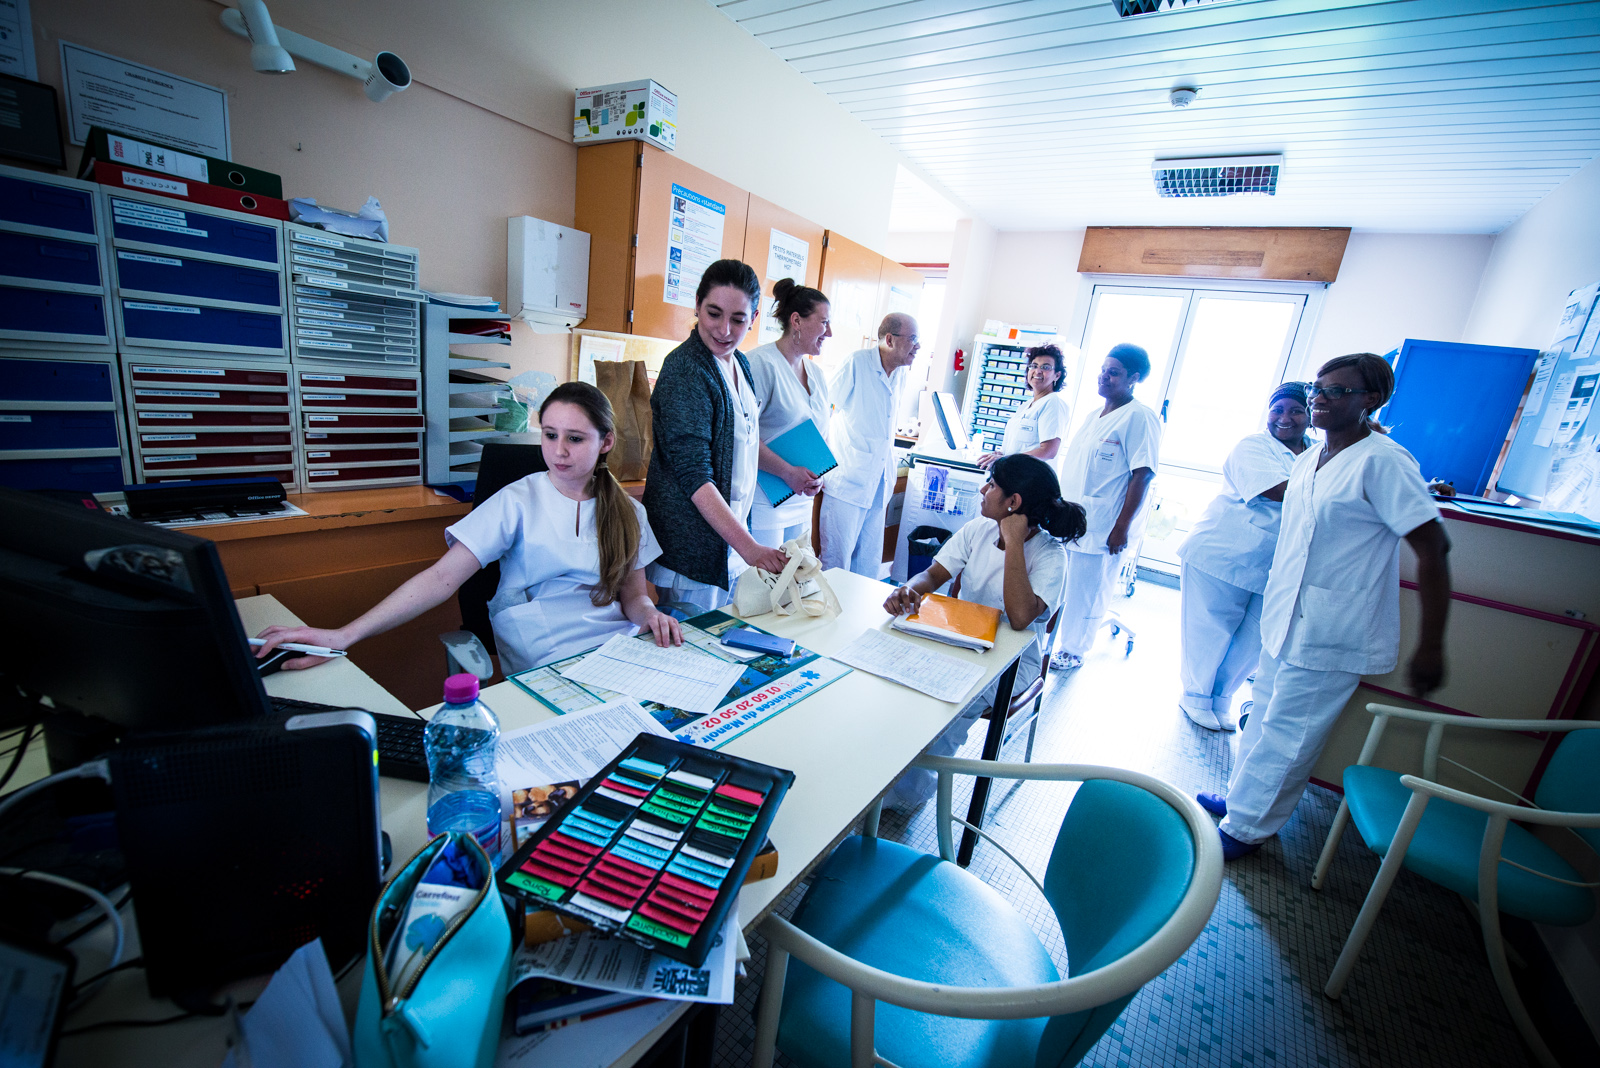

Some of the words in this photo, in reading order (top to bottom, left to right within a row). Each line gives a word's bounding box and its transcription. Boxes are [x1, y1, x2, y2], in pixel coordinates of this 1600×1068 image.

[673, 185, 701, 203] Précautions
[773, 244, 786, 254] PETITS
[755, 680, 814, 713] Ambulances
[770, 685, 782, 696] 01
[751, 692, 768, 703] 60
[735, 700, 754, 711] 20
[719, 708, 738, 720] 50
[741, 710, 758, 722] du
[701, 716, 722, 729] 02
[702, 718, 746, 744] Manoir
[416, 890, 461, 902] Carrefour
